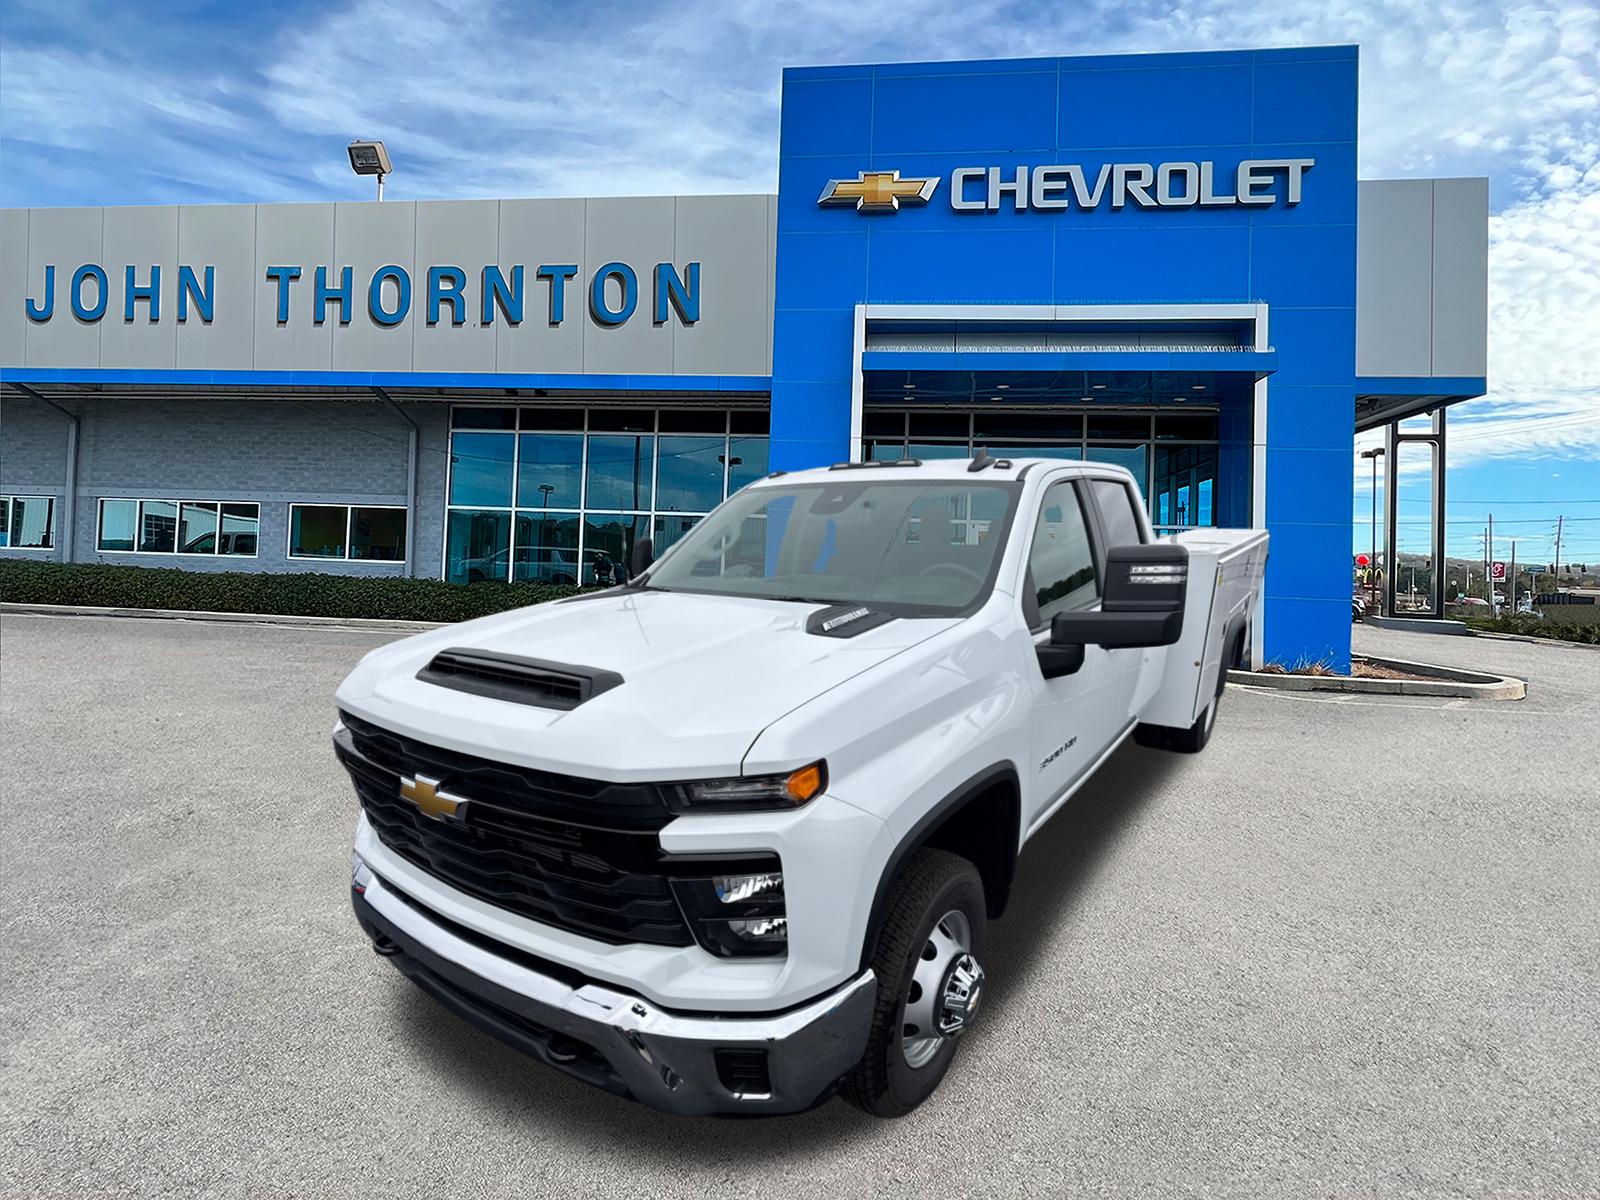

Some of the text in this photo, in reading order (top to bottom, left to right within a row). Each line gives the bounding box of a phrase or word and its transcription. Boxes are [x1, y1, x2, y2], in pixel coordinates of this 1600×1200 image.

[950, 158, 1315, 212] CHEVROLET
[25, 262, 702, 327] JOHN THORNTON
